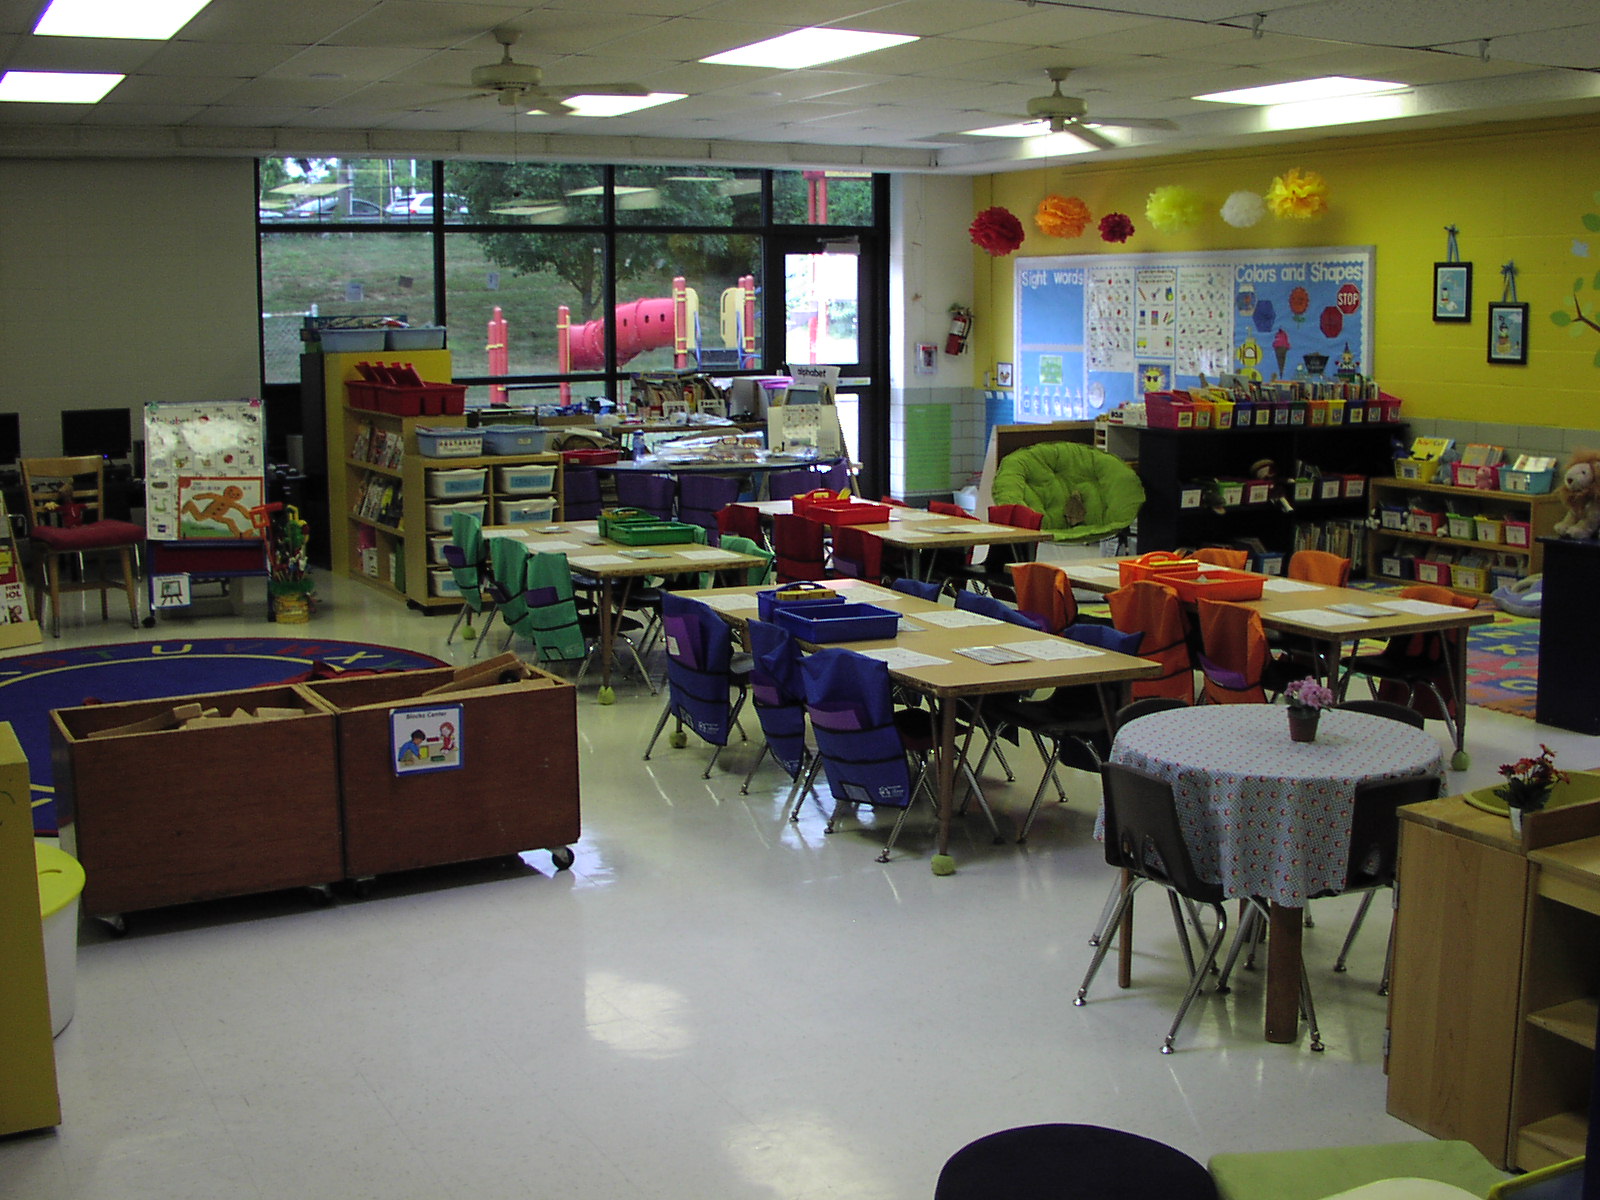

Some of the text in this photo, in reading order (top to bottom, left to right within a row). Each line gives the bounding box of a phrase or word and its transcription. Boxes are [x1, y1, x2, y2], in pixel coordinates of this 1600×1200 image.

[1021, 268, 1084, 290] Sight words
[1236, 262, 1362, 285] Colors and Shapes
[1338, 292, 1359, 306] STOP
[797, 367, 826, 378] alphabet
[151, 643, 193, 655] U
[322, 650, 385, 666] X
